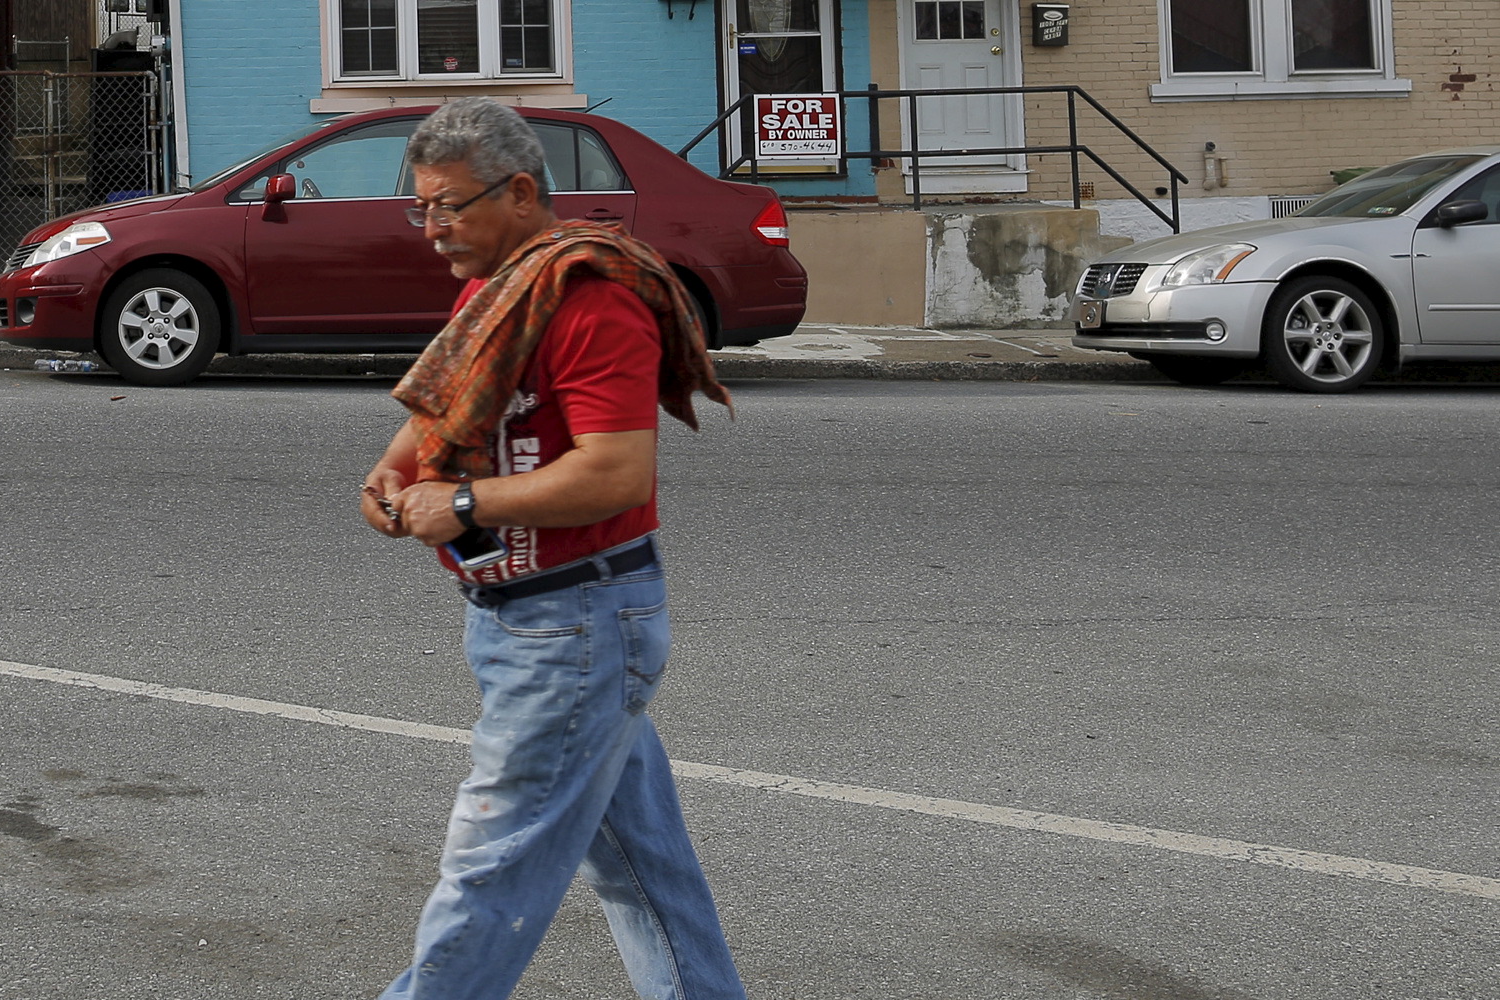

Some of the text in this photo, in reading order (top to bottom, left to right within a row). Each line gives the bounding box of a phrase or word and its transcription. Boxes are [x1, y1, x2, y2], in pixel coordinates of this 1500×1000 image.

[771, 99, 823, 113] FOR
[761, 113, 834, 130] SALE
[768, 129, 828, 139] BY OWNER
